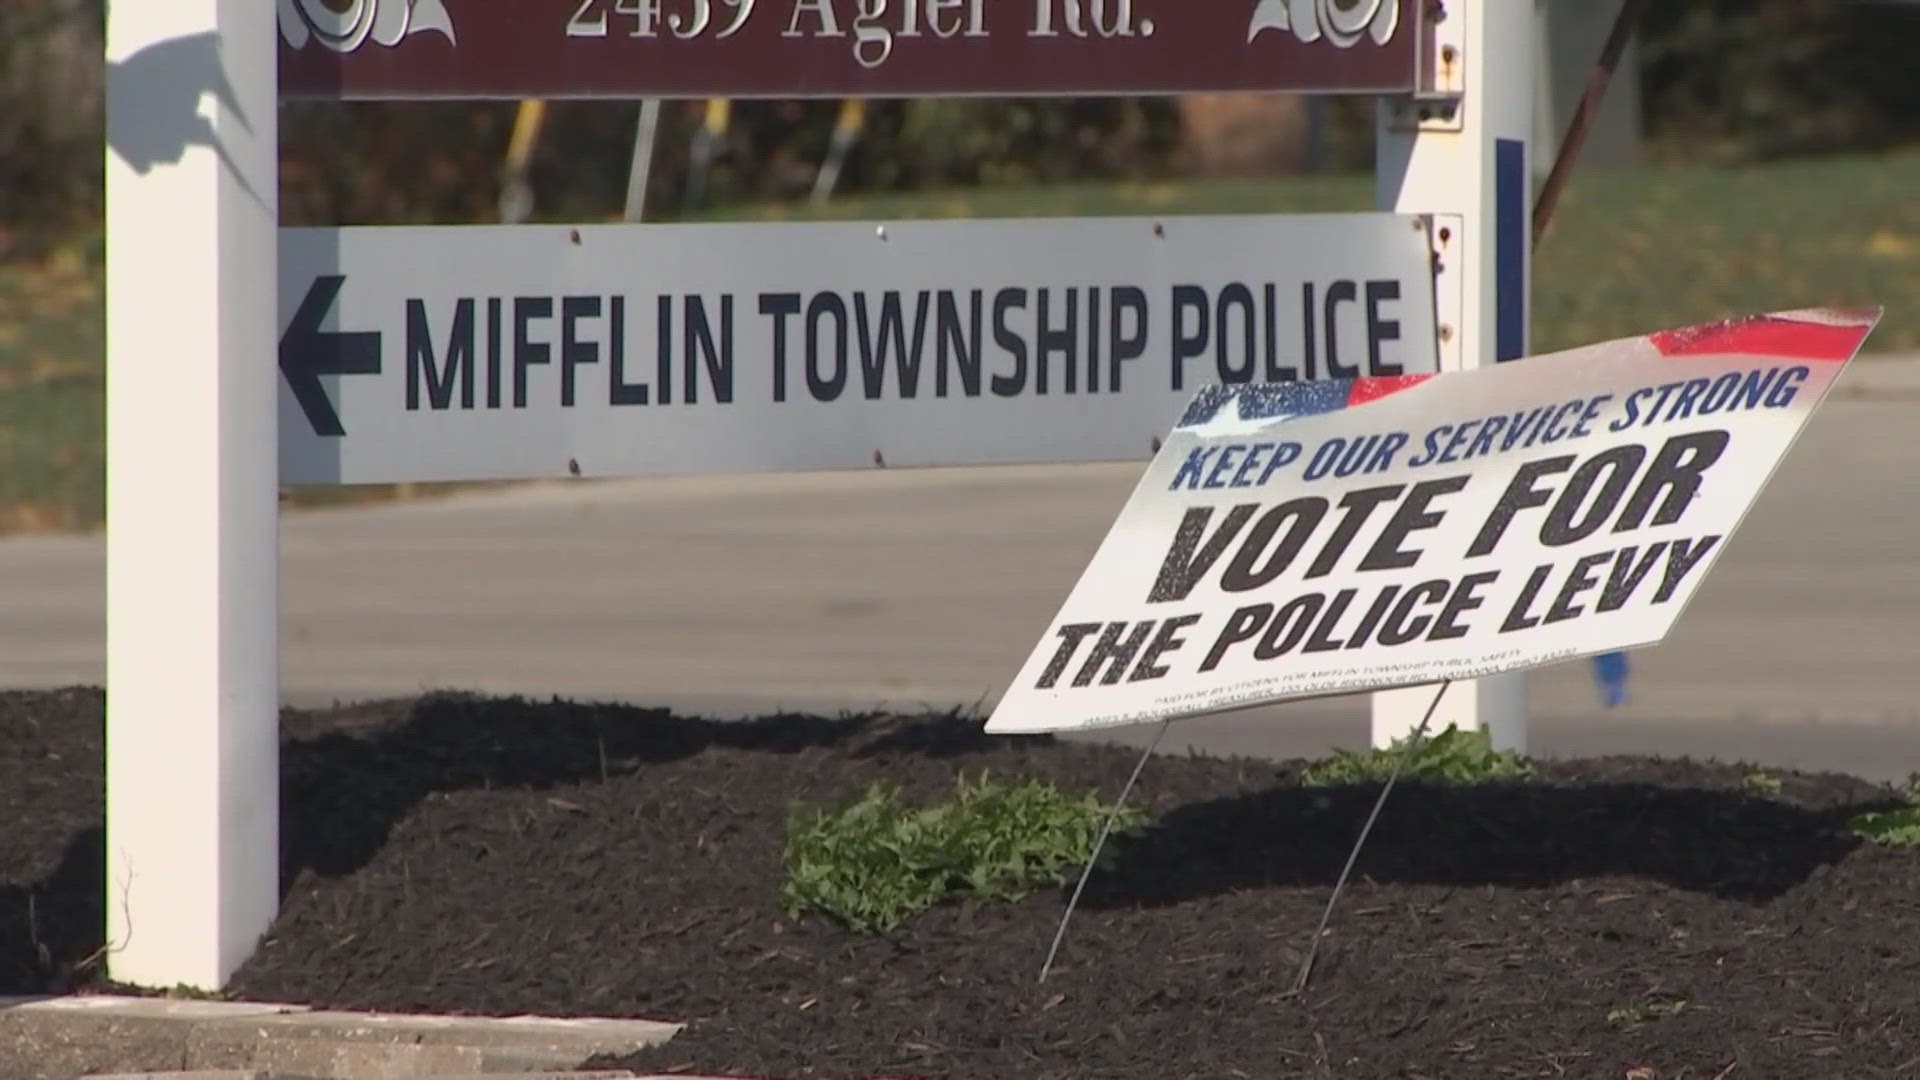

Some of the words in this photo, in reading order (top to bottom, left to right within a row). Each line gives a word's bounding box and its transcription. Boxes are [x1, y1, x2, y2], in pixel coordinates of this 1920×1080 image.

[405, 294, 734, 411] MIFFLIN
[757, 285, 1149, 403] TOWNSHIP
[1171, 279, 1404, 392] POLICE
[1168, 441, 1302, 491] KEEP
[1302, 431, 1408, 482] OUR
[1408, 395, 1612, 468] SERVICE
[1609, 365, 1809, 433] STRONG
[1149, 474, 1470, 603] VOTE
[1465, 430, 1730, 558] FOR
[1036, 614, 1200, 688] THE
[1197, 571, 1500, 673] POLICE
[1500, 535, 1720, 633] LEVY
